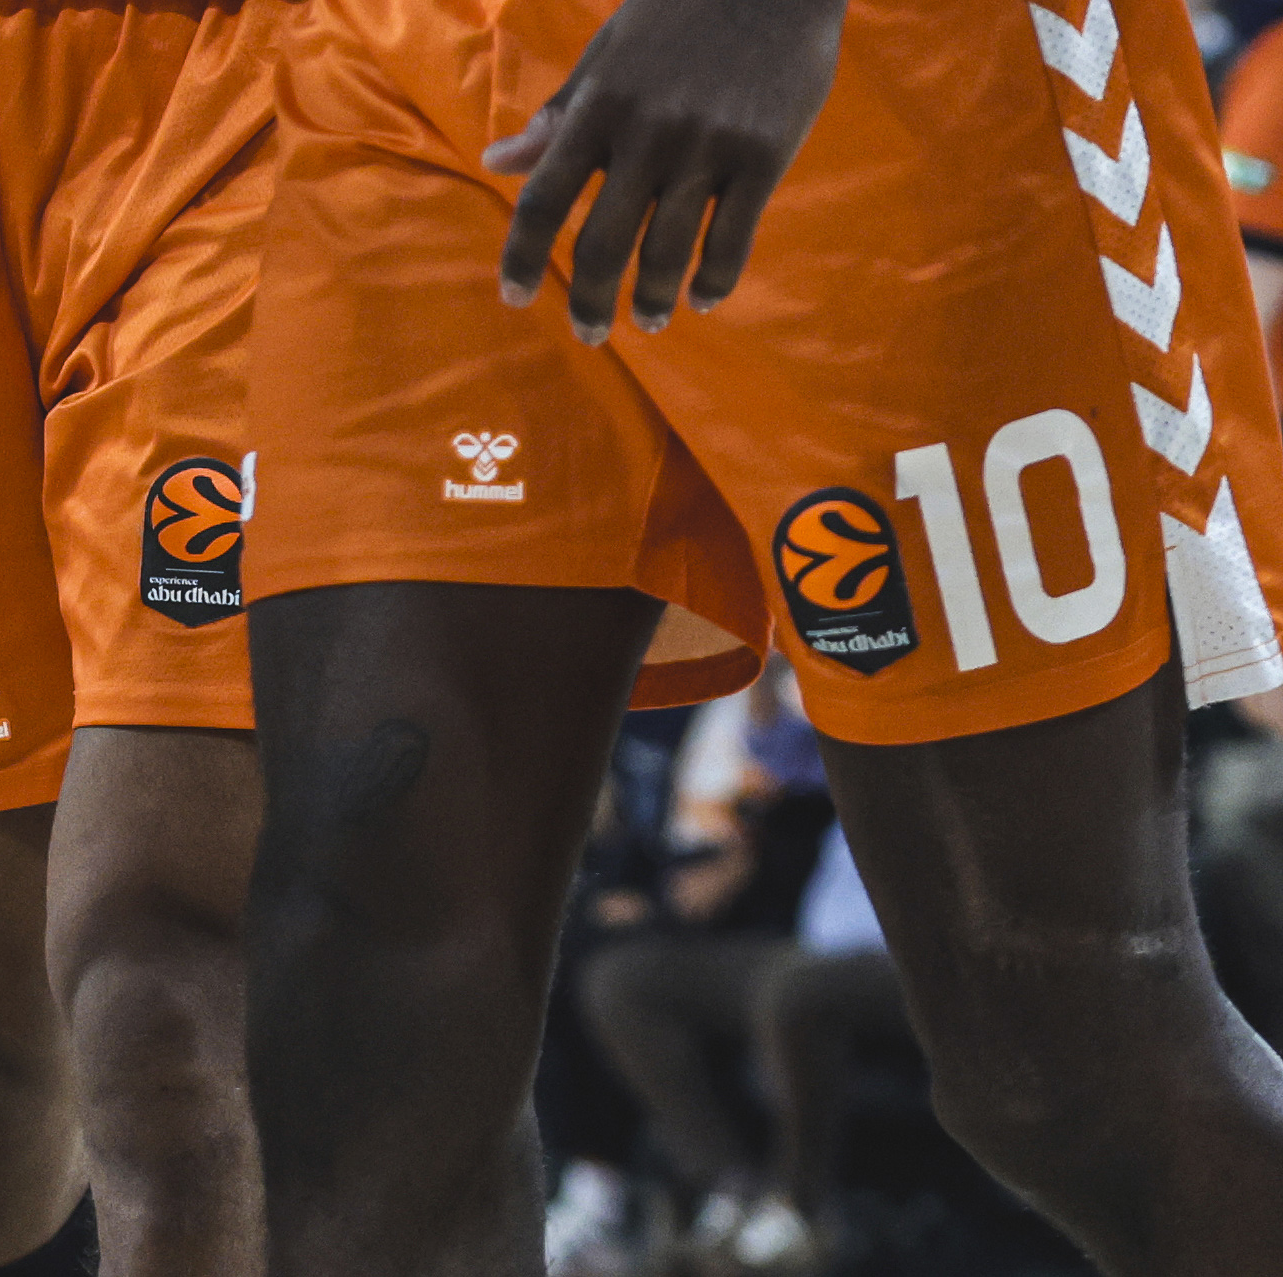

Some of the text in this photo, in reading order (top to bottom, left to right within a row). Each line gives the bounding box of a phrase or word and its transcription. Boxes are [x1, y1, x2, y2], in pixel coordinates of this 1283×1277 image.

[444, 479, 523, 500] hummel
[894, 407, 1127, 672] 10
[149, 576, 198, 586] experience
[147, 585, 241, 606] abu dhabi
